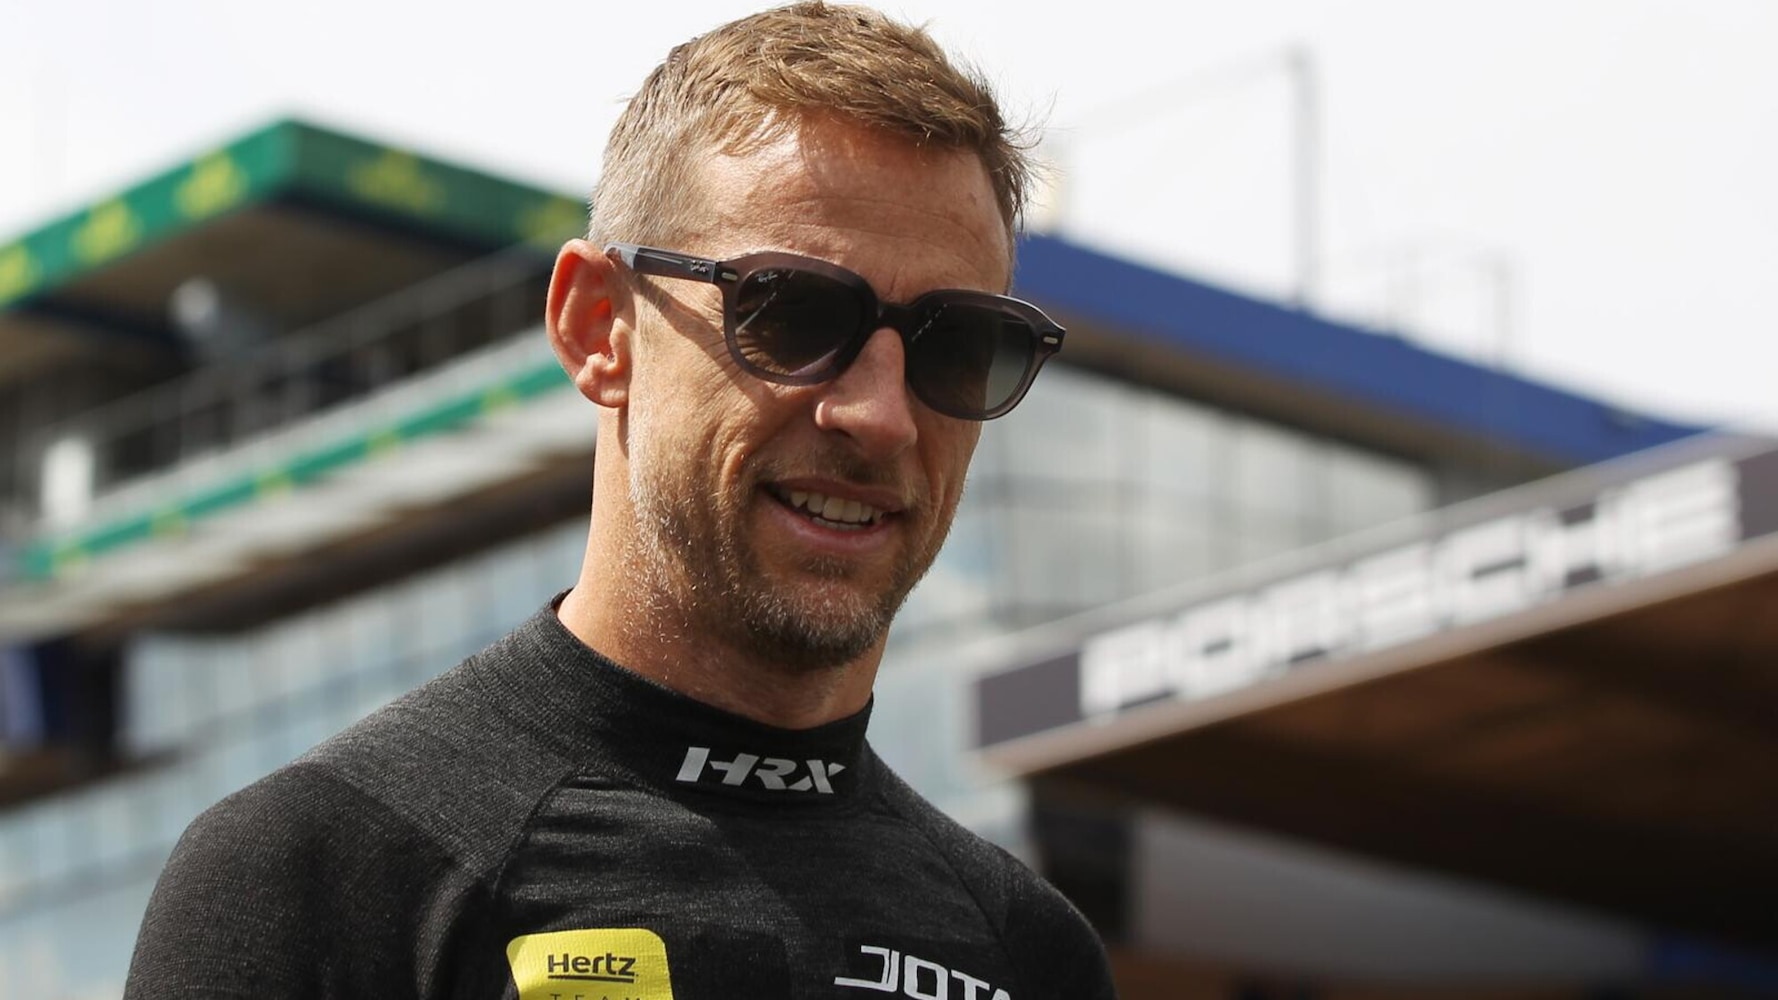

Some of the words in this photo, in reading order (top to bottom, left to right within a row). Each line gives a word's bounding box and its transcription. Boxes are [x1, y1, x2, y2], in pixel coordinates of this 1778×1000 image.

[675, 746, 847, 794] HRX
[548, 953, 637, 977] Hertz
[834, 945, 1011, 1000] JOT
